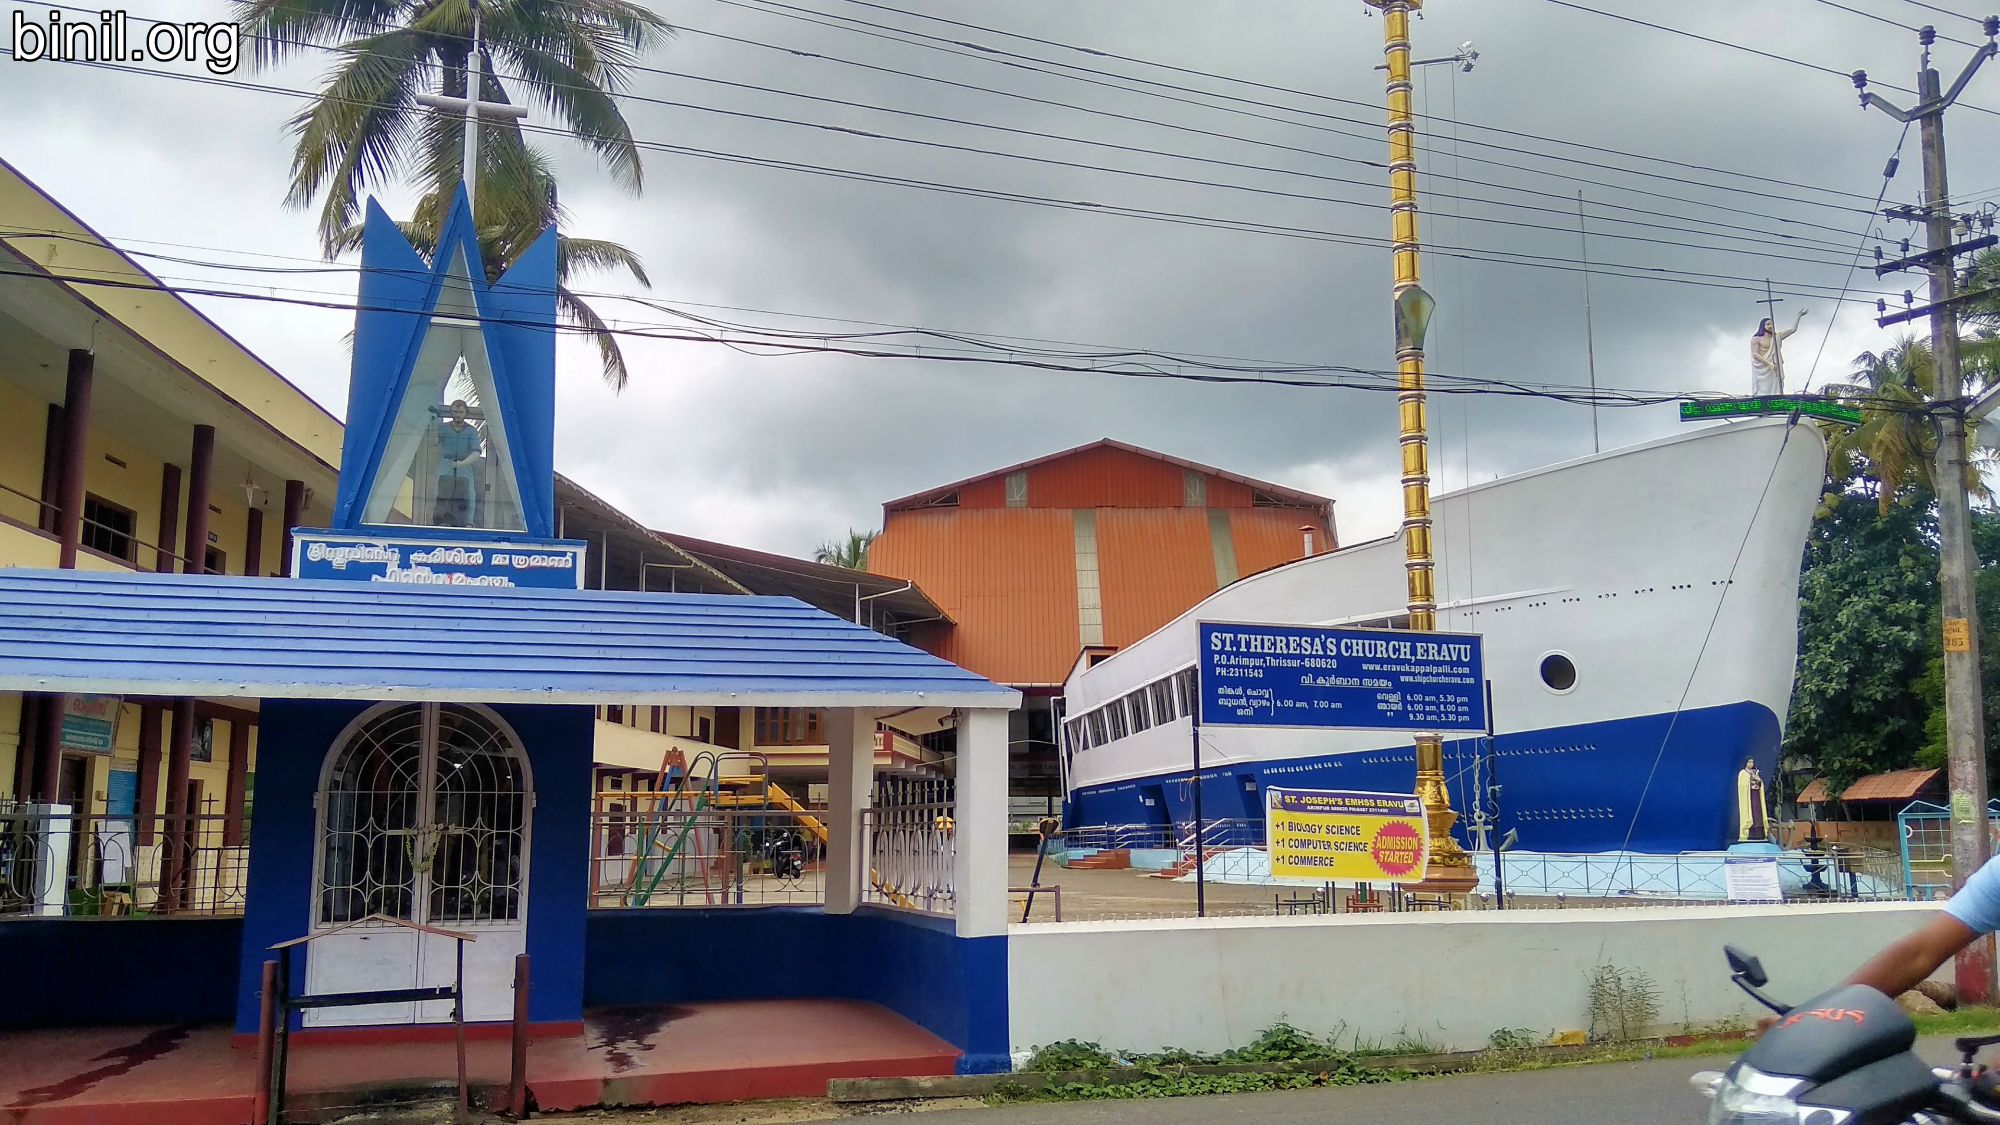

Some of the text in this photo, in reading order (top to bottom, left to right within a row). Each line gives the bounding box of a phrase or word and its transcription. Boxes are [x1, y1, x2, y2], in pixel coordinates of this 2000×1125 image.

[1211, 632, 1472, 663] ST.THERESA'S CHURCH,ERAVU
[1213, 654, 1337, 668] P.O.Arimpur,Thrissur-680620
[1215, 667, 1263, 678] PH:2311543
[1361, 663, 1470, 674] www.eravukappalpalli.com
[1362, 678, 1393, 688] സമയം
[1399, 675, 1475, 684] www.shipchurcheravu.com
[1276, 699, 1294, 708] 6.00
[1313, 700, 1329, 709] 7.00
[1406, 693, 1423, 702] 6.00
[1439, 694, 1455, 703] 5.30
[1456, 696, 1469, 704] pm
[1236, 706, 1254, 716] ശനി
[1407, 703, 1424, 712] 6.00
[1408, 713, 1425, 721] 9.30
[1440, 713, 1457, 721] 5.30
[1457, 715, 1470, 723] pm
[1284, 795, 1405, 809] ST. JOSEPH'S EMHSS ERAVU
[1275, 821, 1361, 836] +1 BIOLOGY SCIENCE
[1275, 838, 1369, 852] +1 COMPUTER SCIENCE
[1376, 836, 1419, 851] ADMISSION
[1275, 855, 1335, 867] +1 COMMERCE
[1379, 851, 1414, 864] STARTED
